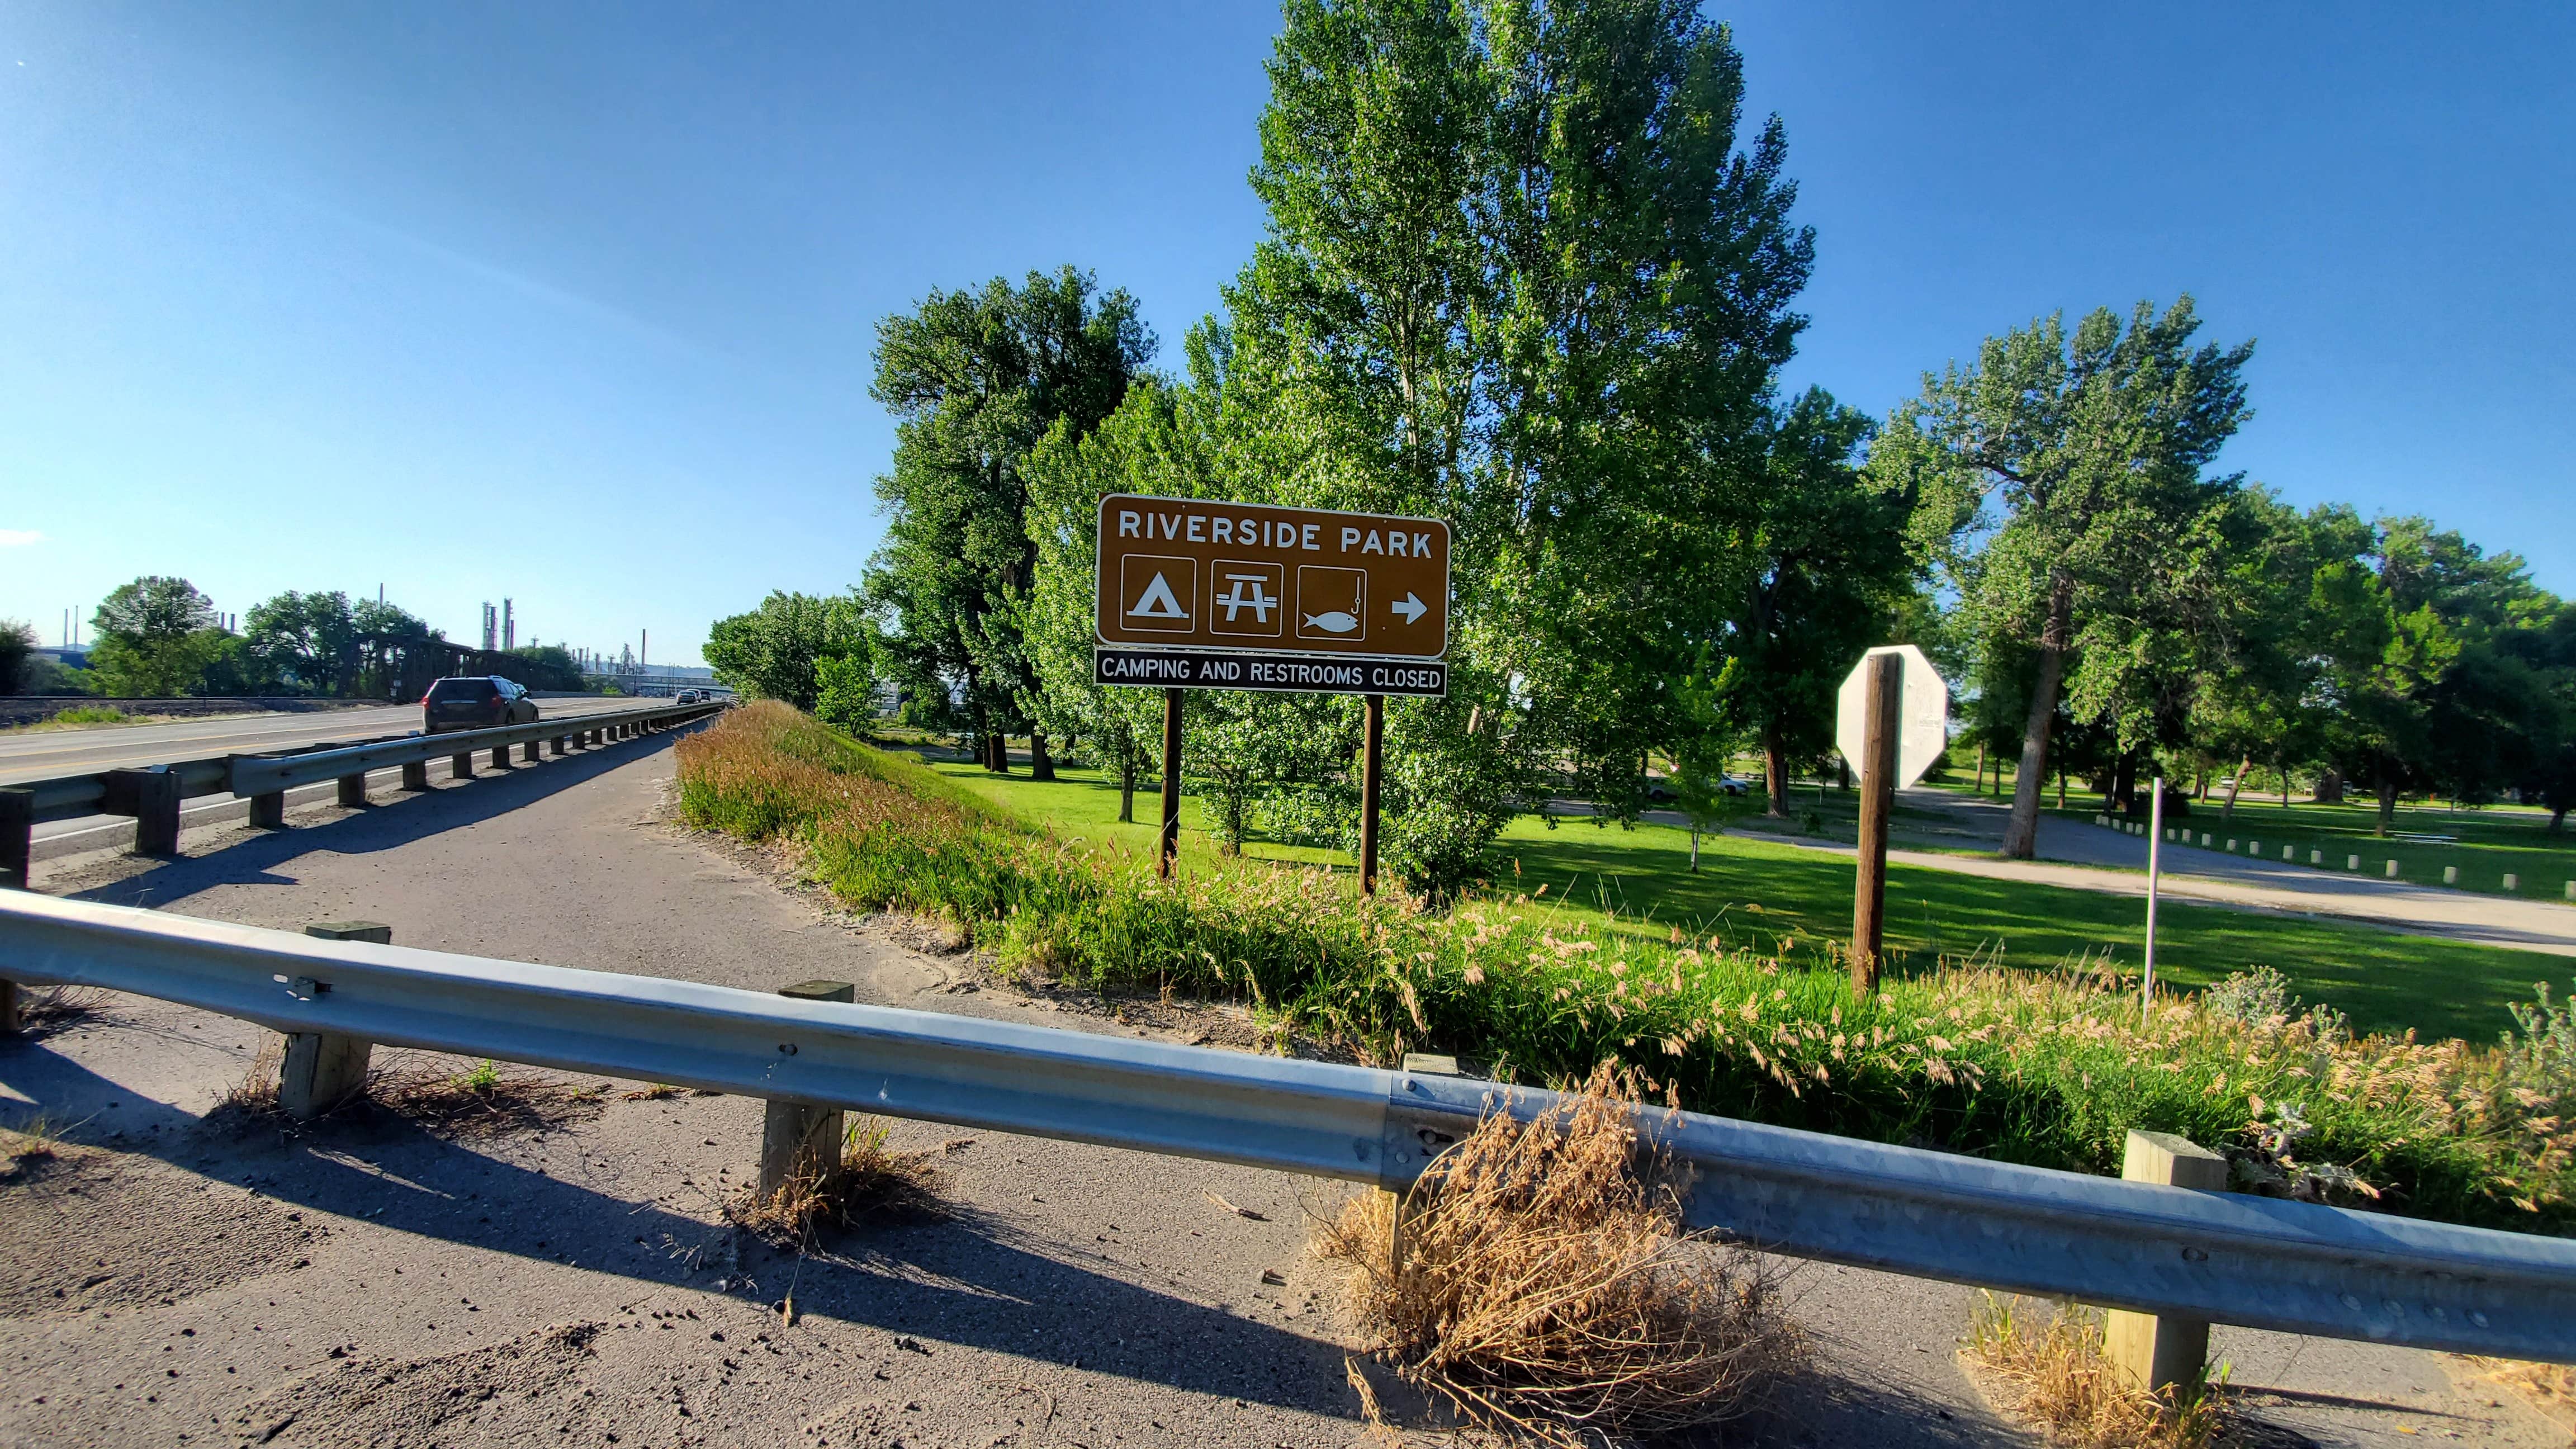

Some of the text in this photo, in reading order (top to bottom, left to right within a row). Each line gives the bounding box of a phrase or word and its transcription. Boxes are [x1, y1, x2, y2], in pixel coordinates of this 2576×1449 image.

[1119, 510, 1432, 558] RIVERSIDE PARK
[1102, 657, 1441, 688] CAMPING AND RESTROOMS CLOSED
